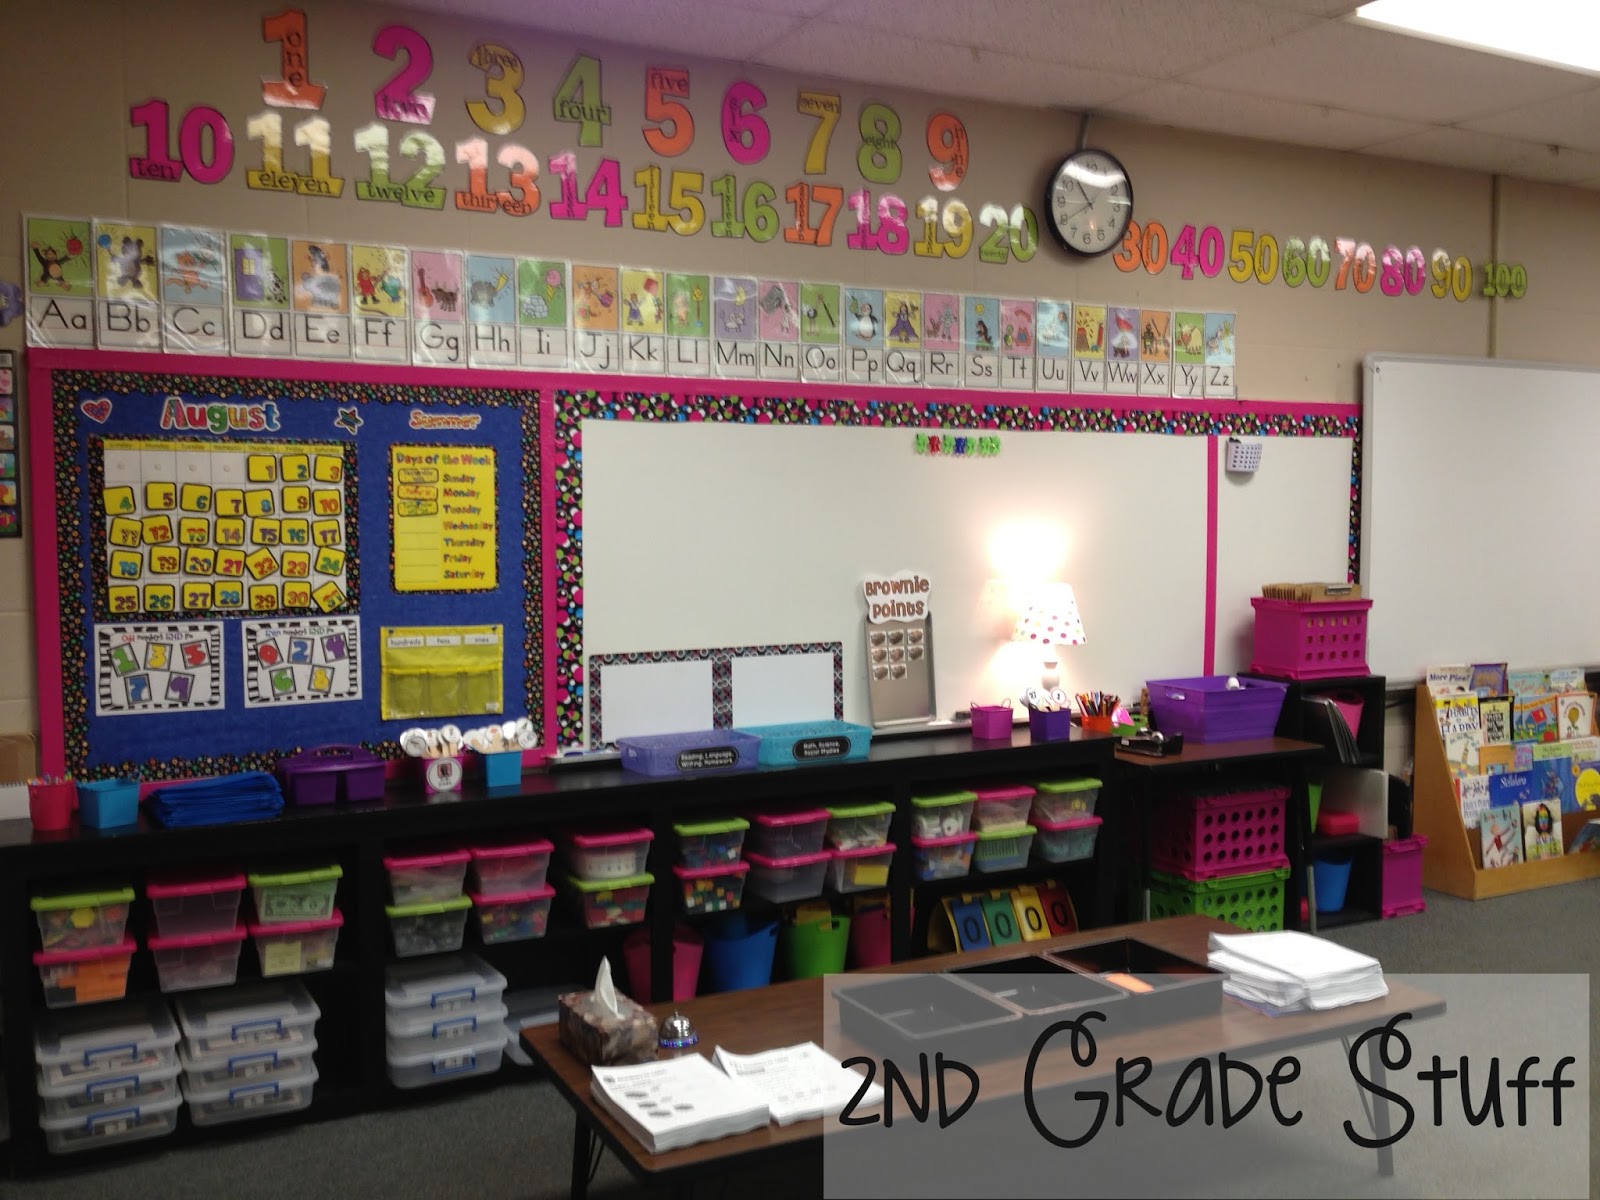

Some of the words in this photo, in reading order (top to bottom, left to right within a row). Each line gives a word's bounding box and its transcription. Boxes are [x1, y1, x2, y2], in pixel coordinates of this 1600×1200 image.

[262, 9, 326, 110] 1
[285, 31, 304, 88] one
[476, 48, 519, 72] three
[372, 25, 436, 125] 2
[466, 41, 526, 135] 3
[649, 70, 688, 92] five
[554, 54, 612, 147] 4
[559, 98, 608, 125] four
[643, 66, 695, 157] 5
[800, 96, 840, 112] seven
[720, 81, 771, 164] 6
[798, 91, 841, 175] 7
[129, 99, 235, 184] 10
[247, 111, 345, 198] 11
[856, 103, 903, 184] 8
[866, 134, 897, 152] eight
[925, 112, 968, 191] 9
[137, 159, 176, 180] ten
[354, 122, 447, 211] 12
[455, 137, 541, 217] 13
[259, 171, 332, 195] eleven
[366, 181, 436, 203] twelve
[548, 152, 628, 227] 14
[461, 190, 532, 215] thirteen
[632, 165, 705, 235] 15
[711, 173, 780, 243] 16
[784, 182, 844, 246] 17
[847, 188, 909, 255] 18
[914, 195, 974, 258] 19
[979, 203, 1039, 264] 20
[1083, 233, 1091, 245] 6
[1113, 220, 1168, 275] 30
[1170, 225, 1225, 280] 40
[1228, 230, 1279, 285] 50
[1282, 237, 1330, 288] 60
[1335, 237, 1377, 294] 70
[1380, 245, 1426, 296] 80
[1430, 248, 1473, 302] 90
[1483, 261, 1528, 299] 100
[38, 298, 88, 330] Aa
[107, 303, 151, 333] Bb
[172, 308, 216, 337] Cc
[242, 311, 284, 342] Dd
[305, 315, 340, 344] Ee
[365, 319, 393, 346] Ff
[419, 323, 460, 362] Gg
[475, 326, 510, 352] Hh
[536, 329, 551, 354] Ii
[579, 333, 611, 369] Jj
[628, 338, 658, 362] Kk
[677, 340, 699, 363] Ll
[716, 342, 755, 367] Mm
[764, 344, 794, 368] Nn
[805, 347, 836, 369] Oo
[851, 348, 879, 378] Pp
[886, 351, 918, 383] Qq
[930, 351, 954, 376] Rr
[971, 354, 993, 377] Ss
[1006, 357, 1027, 379] Tt
[1042, 358, 1064, 381] Uu
[1080, 361, 1099, 382] Vv
[1108, 362, 1138, 384] Ww
[1143, 364, 1165, 386] Xx
[1181, 366, 1198, 390] Yy
[1210, 366, 1230, 387] Zz
[160, 396, 281, 434] August
[409, 409, 482, 430] Summer
[265, 465, 273, 478] 1
[297, 464, 308, 479] 2
[329, 466, 340, 480] 3
[396, 452, 424, 467] Days
[425, 453, 440, 465] of
[442, 453, 460, 465] the
[461, 454, 492, 466] Week
[443, 474, 475, 485] Sunday
[119, 496, 132, 510] 4
[163, 492, 174, 507] 5
[196, 495, 208, 509] 6
[231, 499, 242, 513] 7
[260, 498, 272, 513] 8
[296, 496, 308, 509] 9
[319, 499, 338, 513] 10
[443, 489, 480, 500] Monday
[443, 505, 482, 516] Tuesday
[149, 525, 170, 542] 12
[186, 528, 207, 543] 13
[221, 527, 242, 543] 14
[258, 528, 279, 543] 15
[286, 528, 306, 543] 16
[319, 529, 338, 544] 17
[443, 520, 494, 532] Wednesday
[443, 538, 486, 548] Thursday
[118, 561, 139, 576] 18
[157, 556, 178, 571] 19
[189, 557, 212, 572] 20
[222, 558, 242, 573] 21
[254, 557, 276, 576] 22
[286, 560, 307, 575] 23
[321, 557, 340, 572] 24
[443, 554, 473, 564] Friday
[444, 570, 485, 580] Saturday
[865, 575, 930, 596] Brownie
[114, 596, 137, 611] 25
[149, 594, 172, 609] 26
[188, 592, 210, 607] 27
[220, 590, 241, 606] 28
[254, 595, 276, 610] 29
[287, 590, 308, 605] 30
[112, 645, 136, 675] 1
[147, 644, 168, 669] 3
[184, 643, 206, 666] 5
[259, 643, 279, 665] 0
[292, 640, 309, 663] 2
[325, 635, 346, 660] 4
[128, 676, 148, 701] 7
[170, 676, 190, 701] 9
[273, 670, 293, 691] 6
[313, 667, 330, 690] 8
